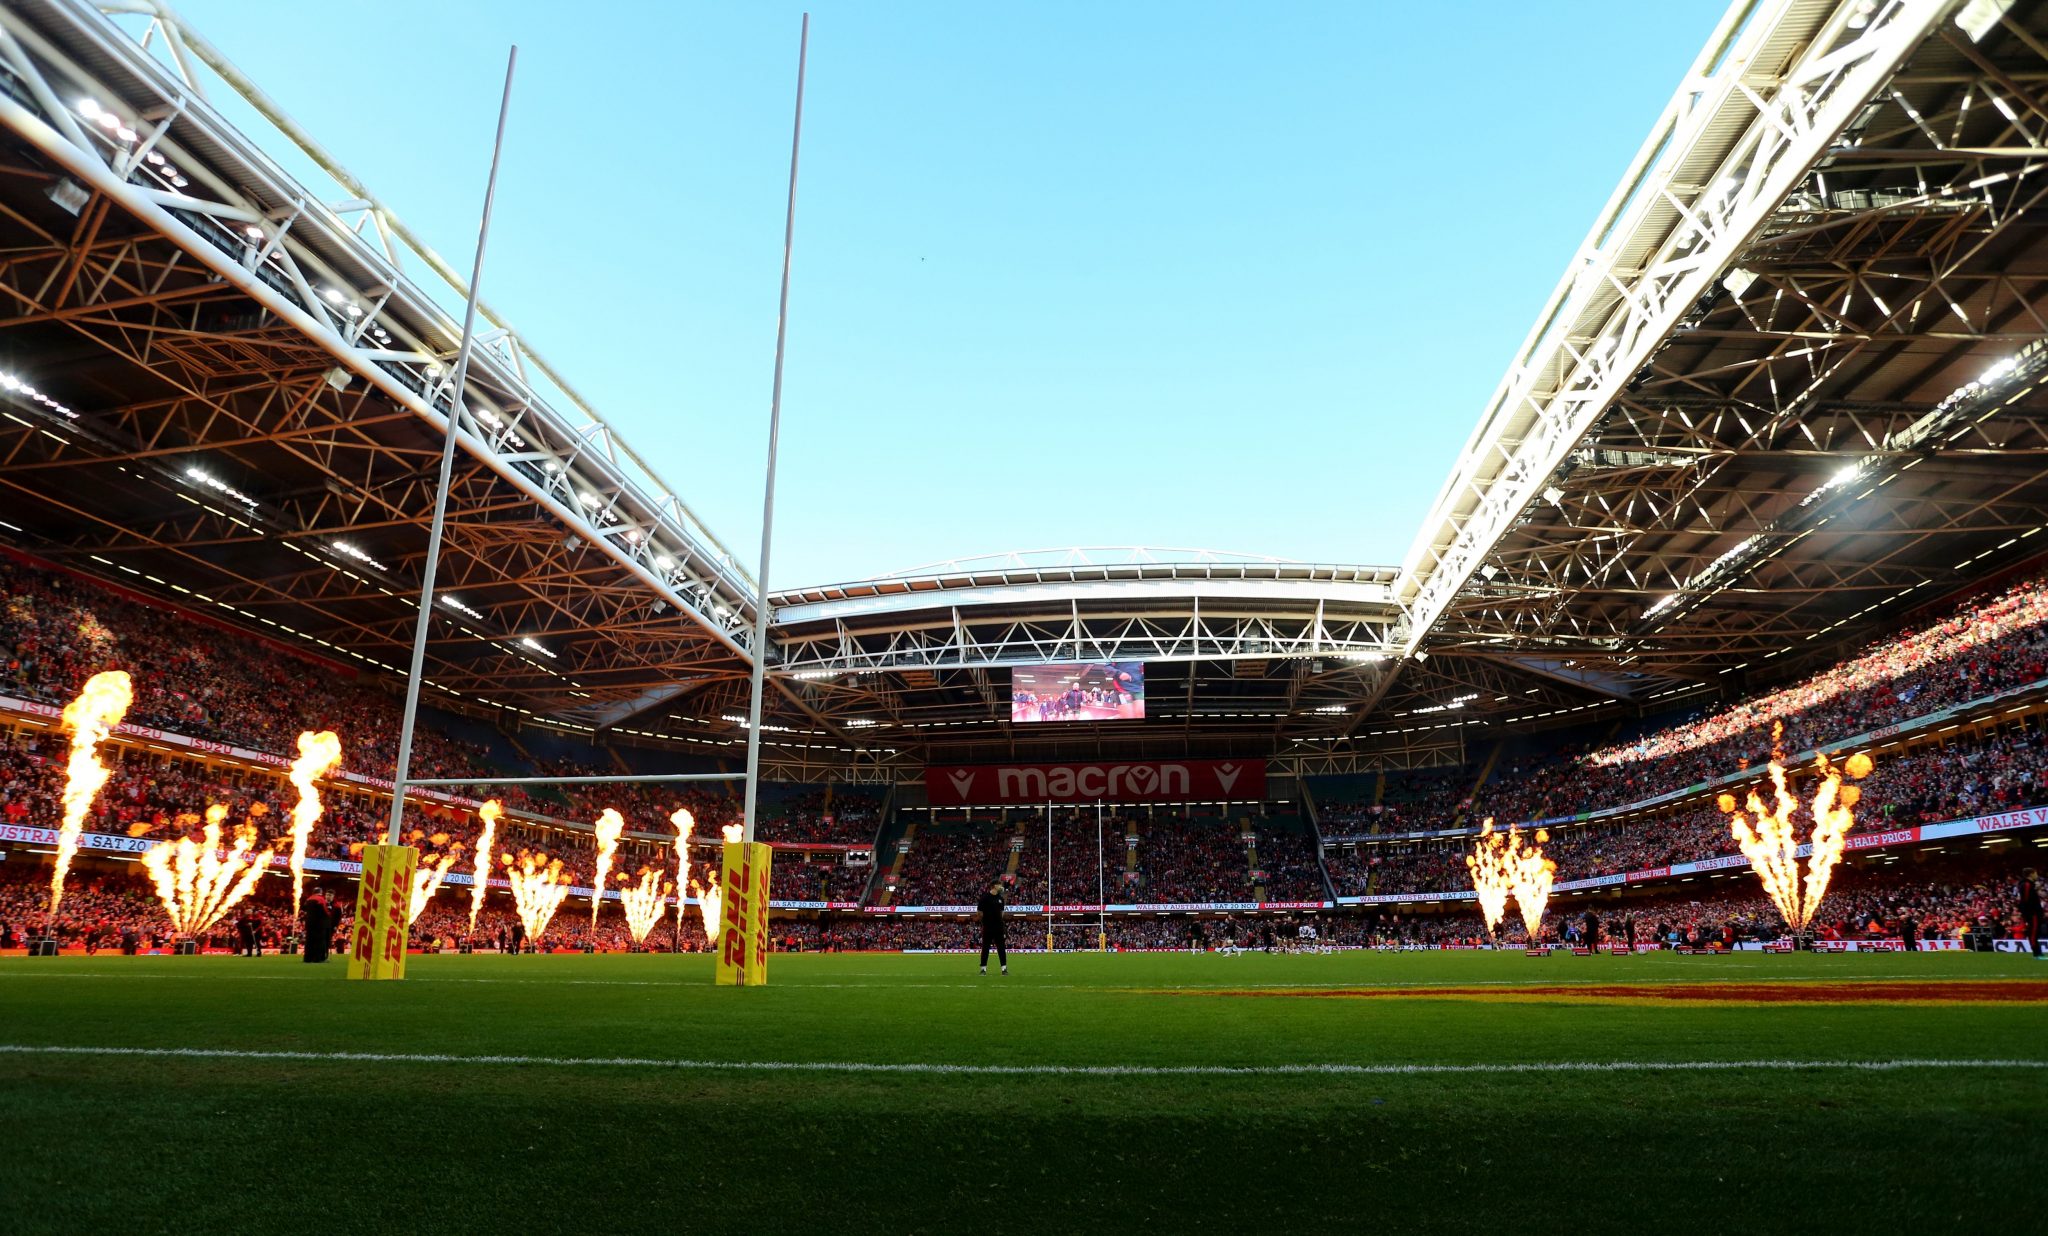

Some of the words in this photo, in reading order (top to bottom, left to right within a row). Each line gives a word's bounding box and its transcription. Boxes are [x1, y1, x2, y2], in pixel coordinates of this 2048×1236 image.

[21, 701, 63, 718] ISUZ
[1869, 726, 1900, 740] CAZOO
[190, 738, 233, 754] ISUZU
[998, 764, 1190, 797] macron
[1854, 836, 1879, 848] HALF
[1882, 831, 1912, 844] PRICE
[1977, 812, 2031, 831] WALES
[2035, 808, 2048, 823] V
[92, 836, 124, 850] SAT
[129, 840, 147, 851] 20
[340, 862, 362, 873] WAL
[1694, 860, 1718, 871] WALES
[1397, 893, 1441, 901] AUSTRALIA
[356, 863, 383, 964] DHL
[384, 865, 411, 963] DHL
[724, 862, 750, 969] DHL
[756, 864, 769, 968] DHL
